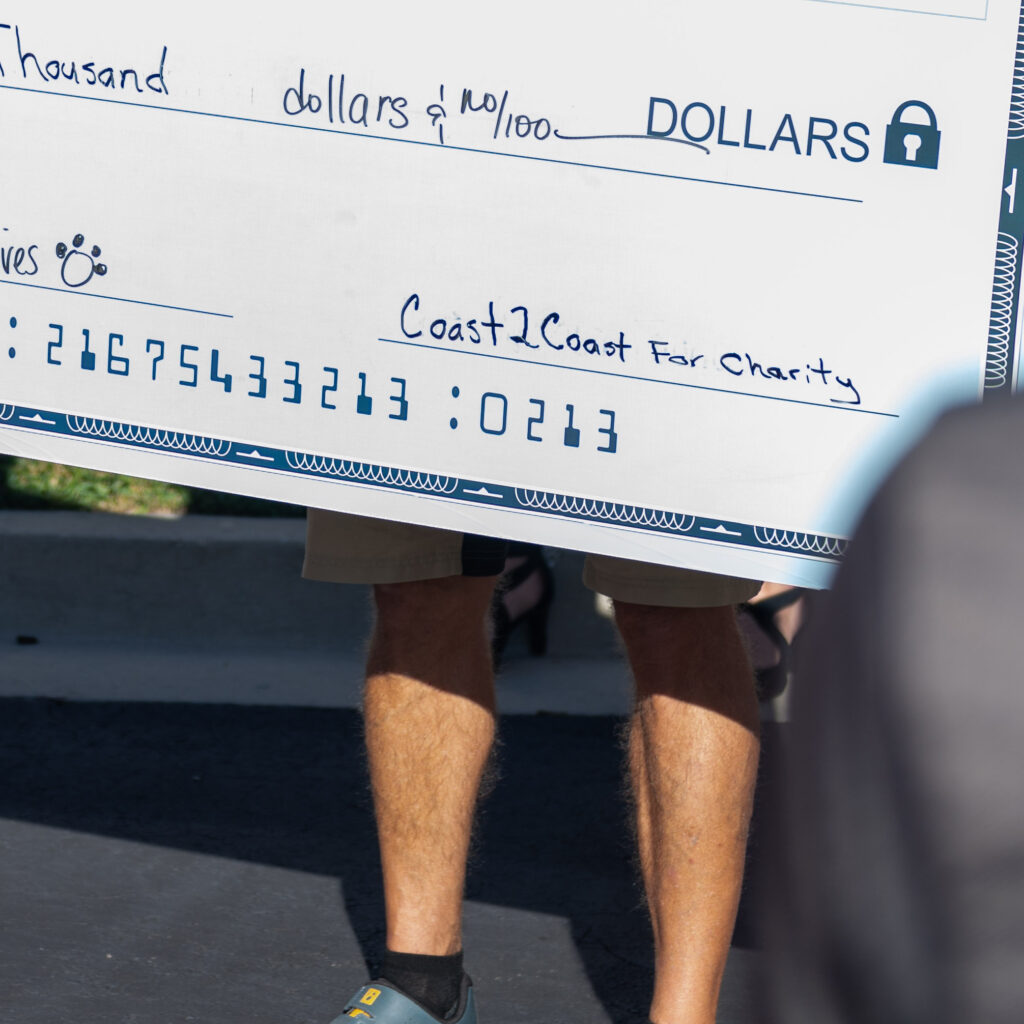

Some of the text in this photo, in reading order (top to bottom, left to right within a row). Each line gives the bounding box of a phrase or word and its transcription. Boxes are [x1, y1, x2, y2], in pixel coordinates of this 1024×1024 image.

[282, 67, 410, 129] dollars
[646, 96, 871, 164] DOLLARS
[719, 352, 862, 406] Charity
